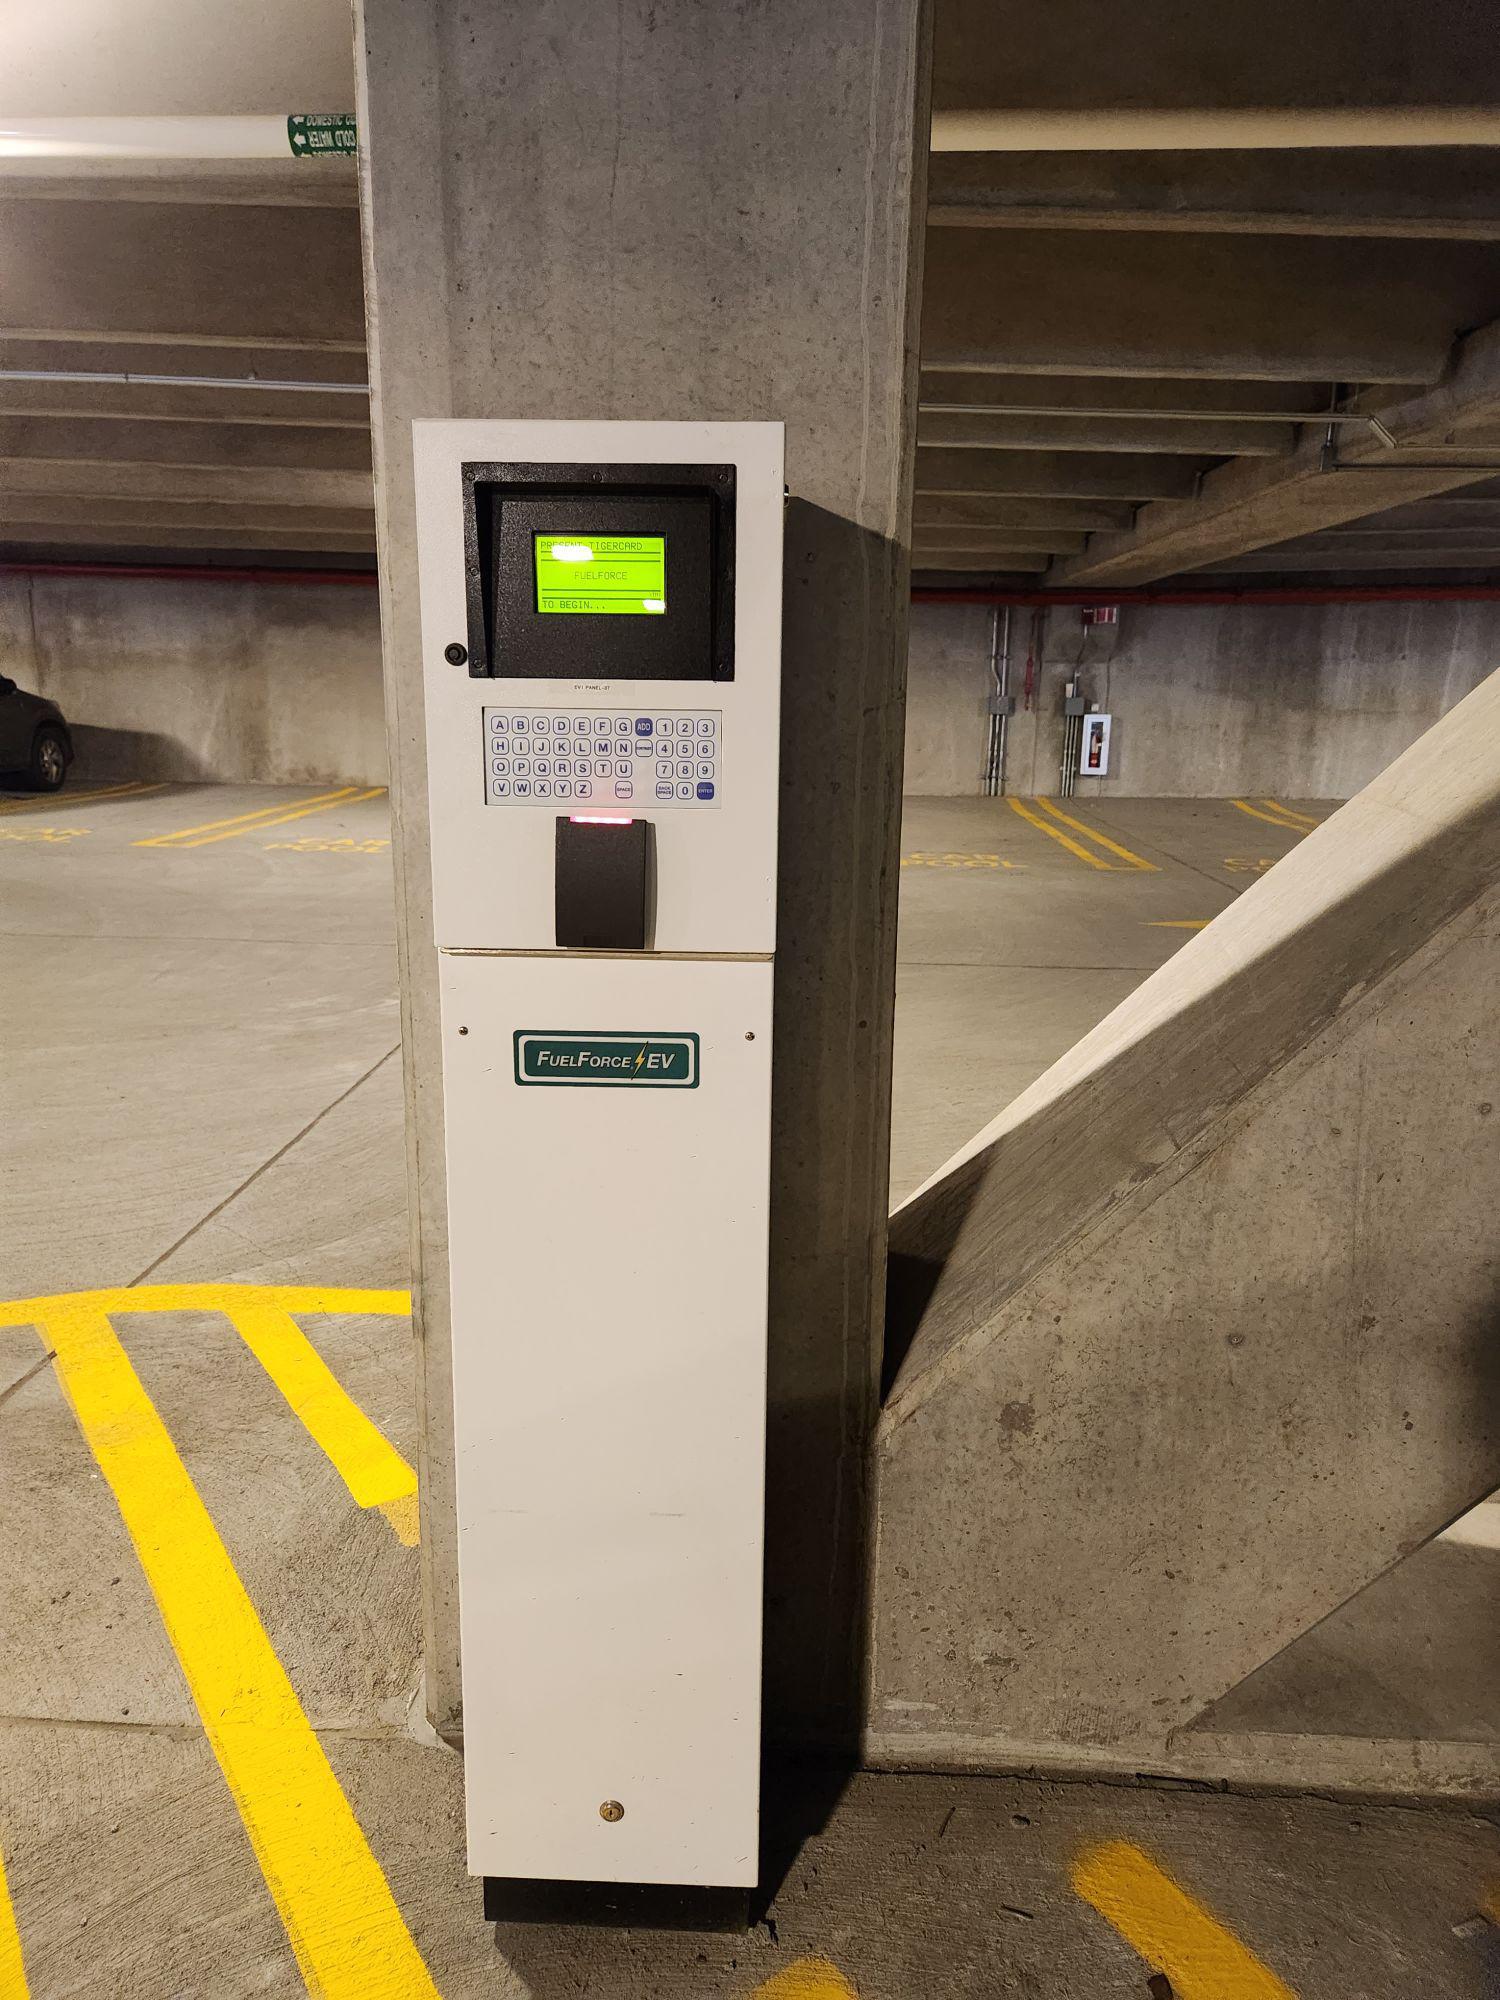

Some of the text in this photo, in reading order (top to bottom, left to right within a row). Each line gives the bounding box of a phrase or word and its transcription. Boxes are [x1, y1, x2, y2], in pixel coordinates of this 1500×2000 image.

[308, 130, 356, 148] COLD WATER
[590, 542, 642, 551] TIGERCARD
[574, 572, 628, 580] FUELFORCE
[543, 600, 606, 610] TO BEGIN...
[496, 720, 504, 730] A
[517, 720, 525, 730] B
[536, 720, 545, 731] C
[557, 721, 566, 731] D
[578, 721, 586, 731] E
[599, 721, 606, 732] F
[619, 721, 628, 732] G
[682, 723, 689, 733] 2
[702, 723, 709, 733] 3
[496, 741, 505, 751] H
[538, 742, 545, 752] J
[558, 742, 567, 752] K
[579, 743, 586, 752] L
[598, 743, 608, 753] M
[619, 743, 628, 753] N
[661, 744, 668, 753] 4
[681, 744, 689, 754] 5
[702, 744, 709, 754] 6
[496, 762, 709, 775] O P Q R S T U 7 8 9
[497, 783, 506, 792] V
[516, 783, 527, 793] W
[538, 784, 547, 793] X
[559, 784, 567, 794] Y
[579, 784, 587, 794] Z
[681, 786, 689, 796] 0
[646, 1053, 676, 1069] EV
